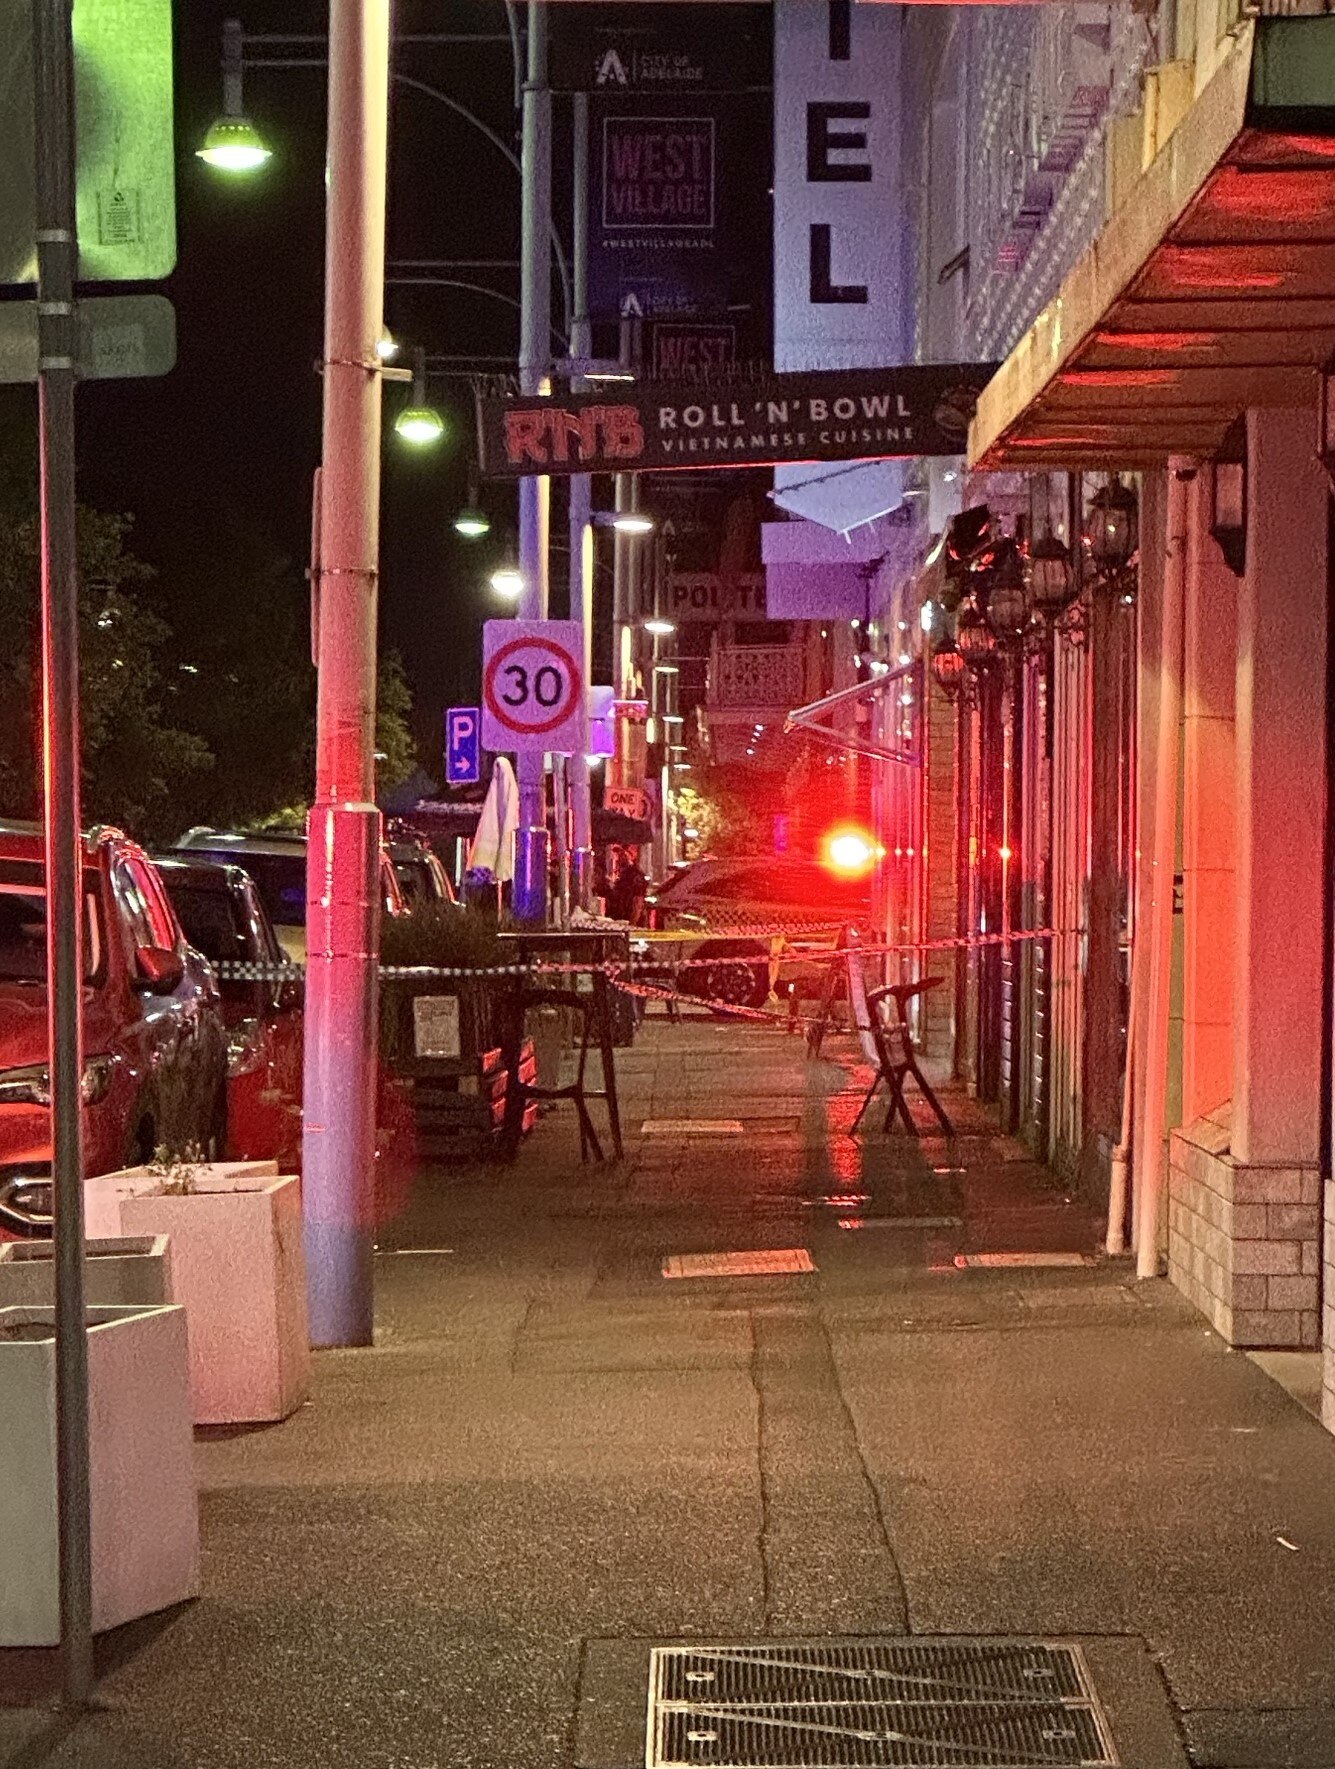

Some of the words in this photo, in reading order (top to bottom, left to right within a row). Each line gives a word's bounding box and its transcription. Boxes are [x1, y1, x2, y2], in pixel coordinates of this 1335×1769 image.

[612, 134, 706, 179] WEST
[611, 184, 706, 214] VILLAGE
[659, 336, 730, 368] WEST
[659, 404, 745, 429] ROLL
[809, 395, 911, 422] BOWL
[661, 432, 806, 452] VIETNAMESE
[820, 426, 913, 444] CUISINE
[502, 665, 563, 707] 30
[453, 716, 473, 750] P
[611, 792, 635, 804] ONE
